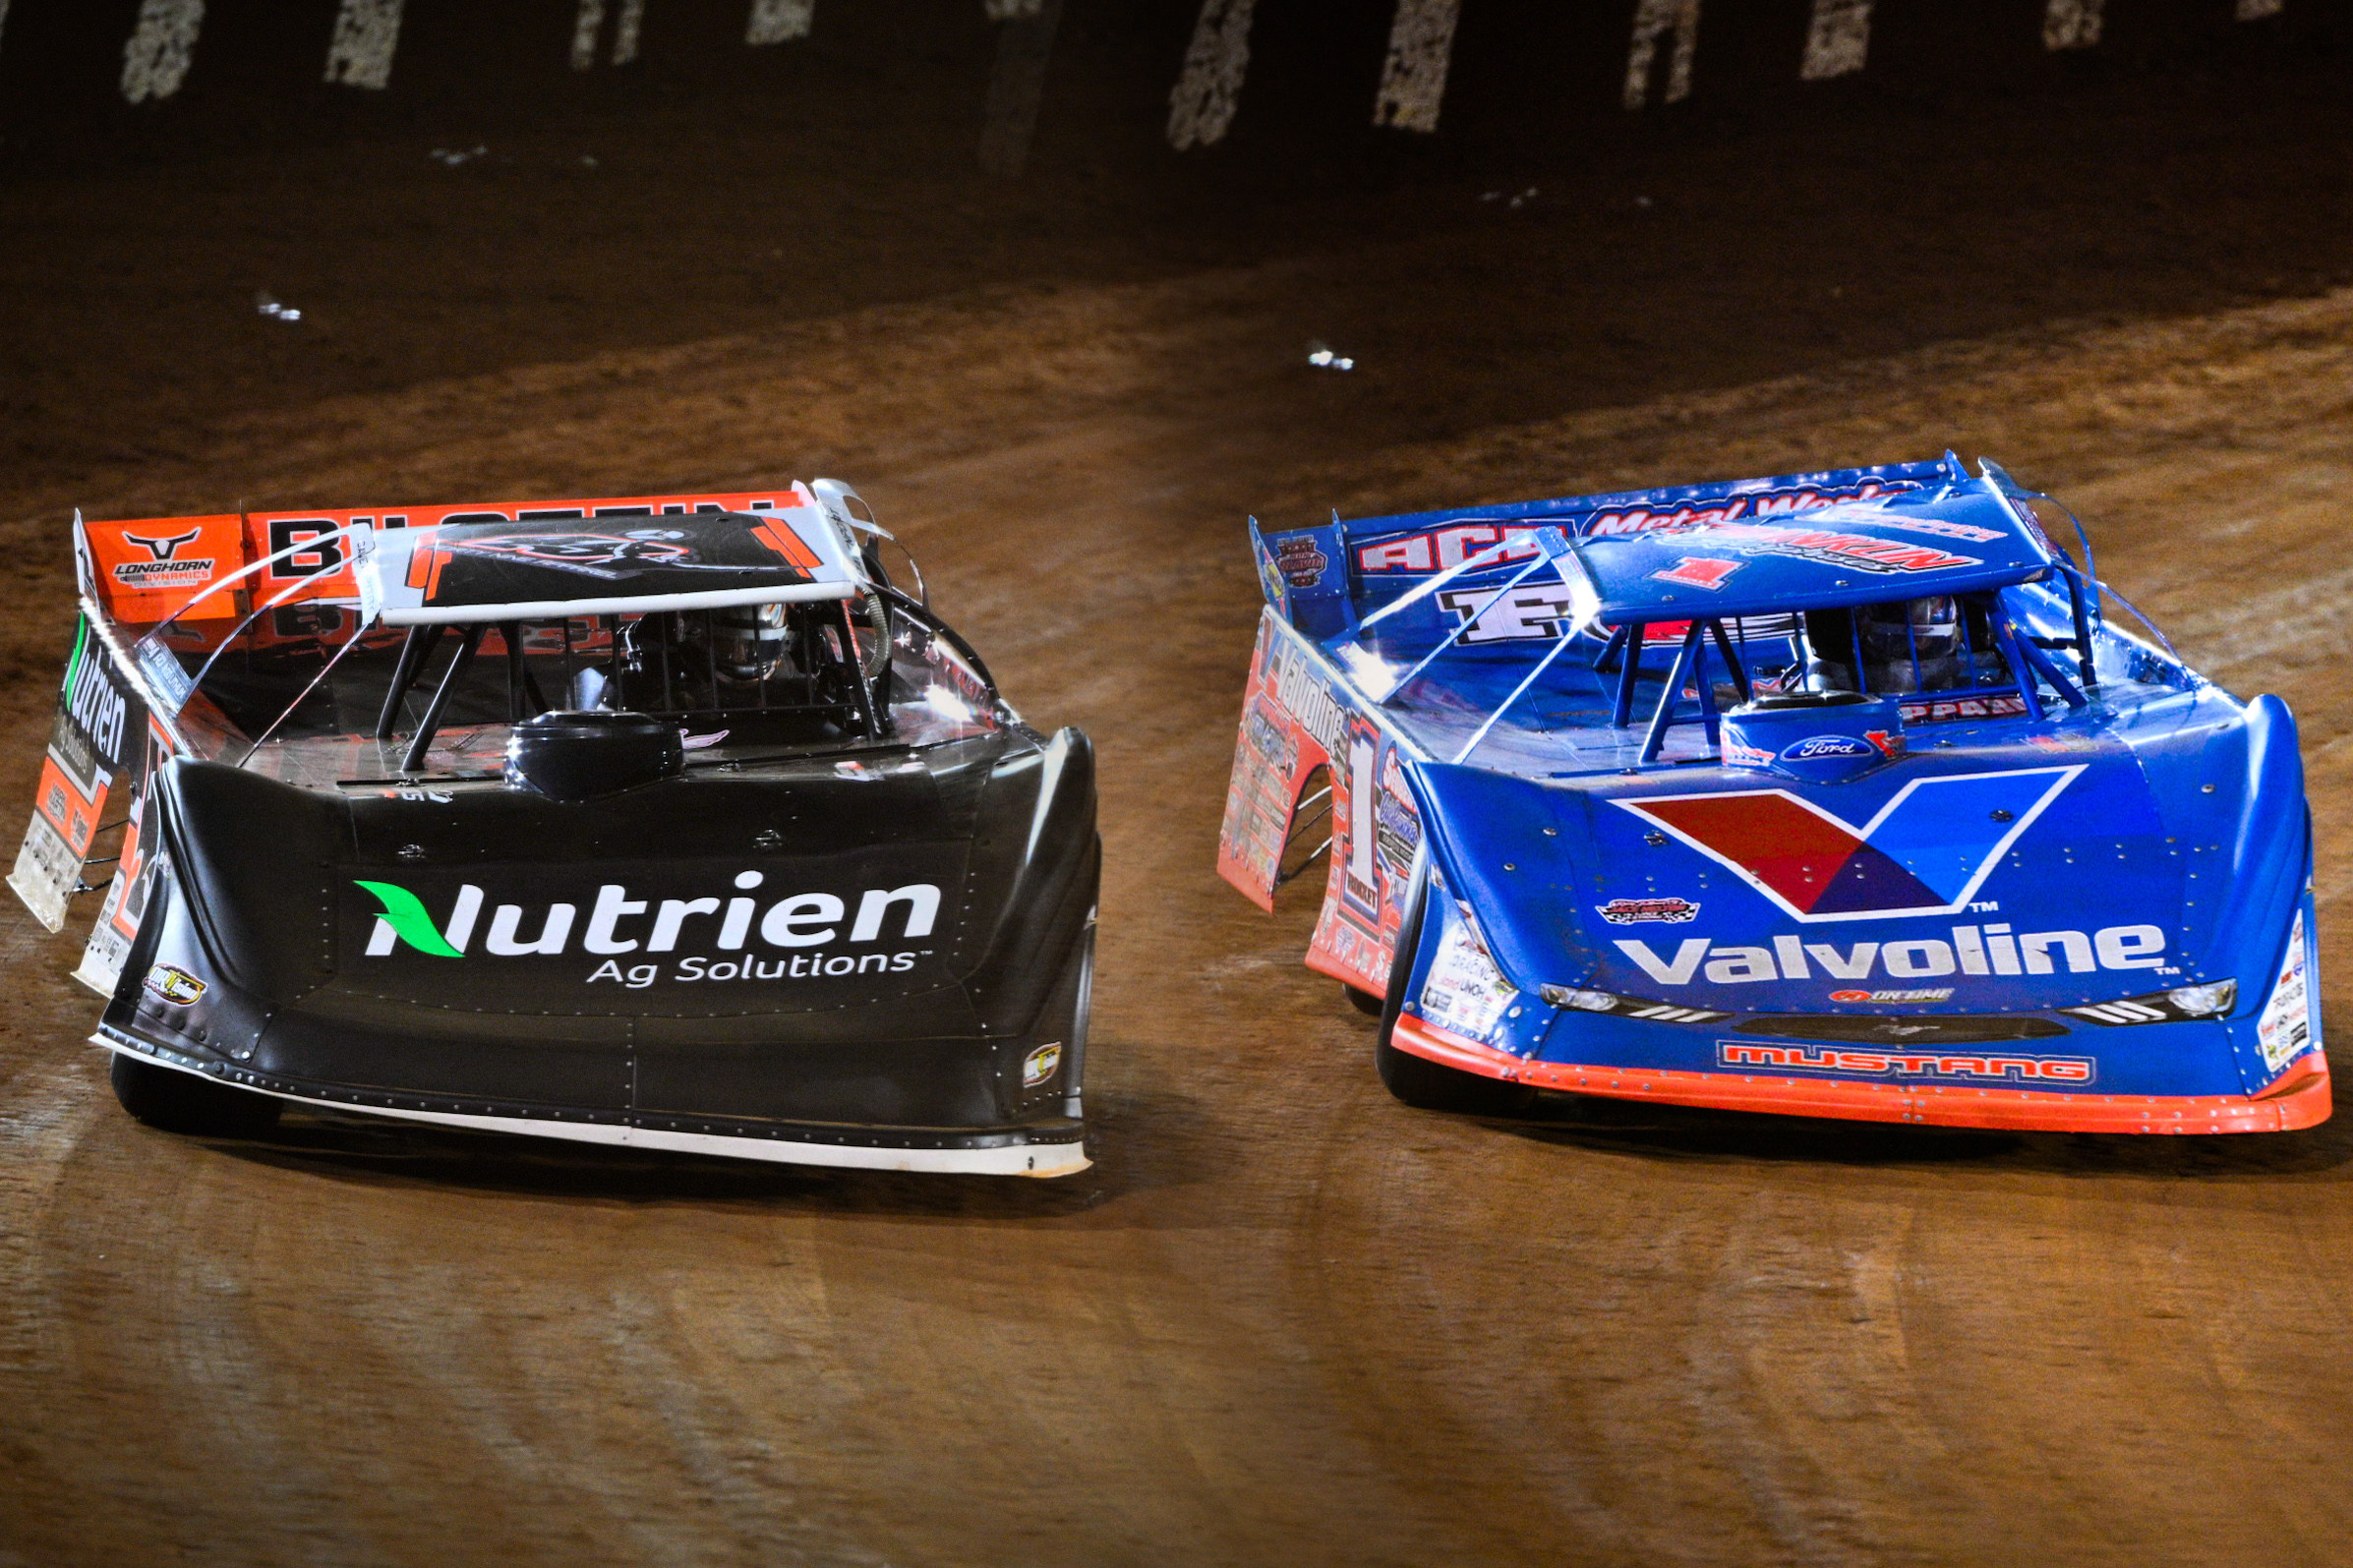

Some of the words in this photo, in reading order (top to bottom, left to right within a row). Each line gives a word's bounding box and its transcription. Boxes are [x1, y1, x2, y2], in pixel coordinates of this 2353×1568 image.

[115, 560, 212, 575] LONGHORN
[145, 570, 208, 582] DYNAMICS
[1800, 739, 1854, 757] Ford
[353, 870, 941, 958] Nutrien
[586, 958, 658, 989] Ag
[676, 950, 915, 982] Solutions
[1613, 924, 2164, 984] Valvoline
[1722, 1044, 2090, 1080] MUSTANG
